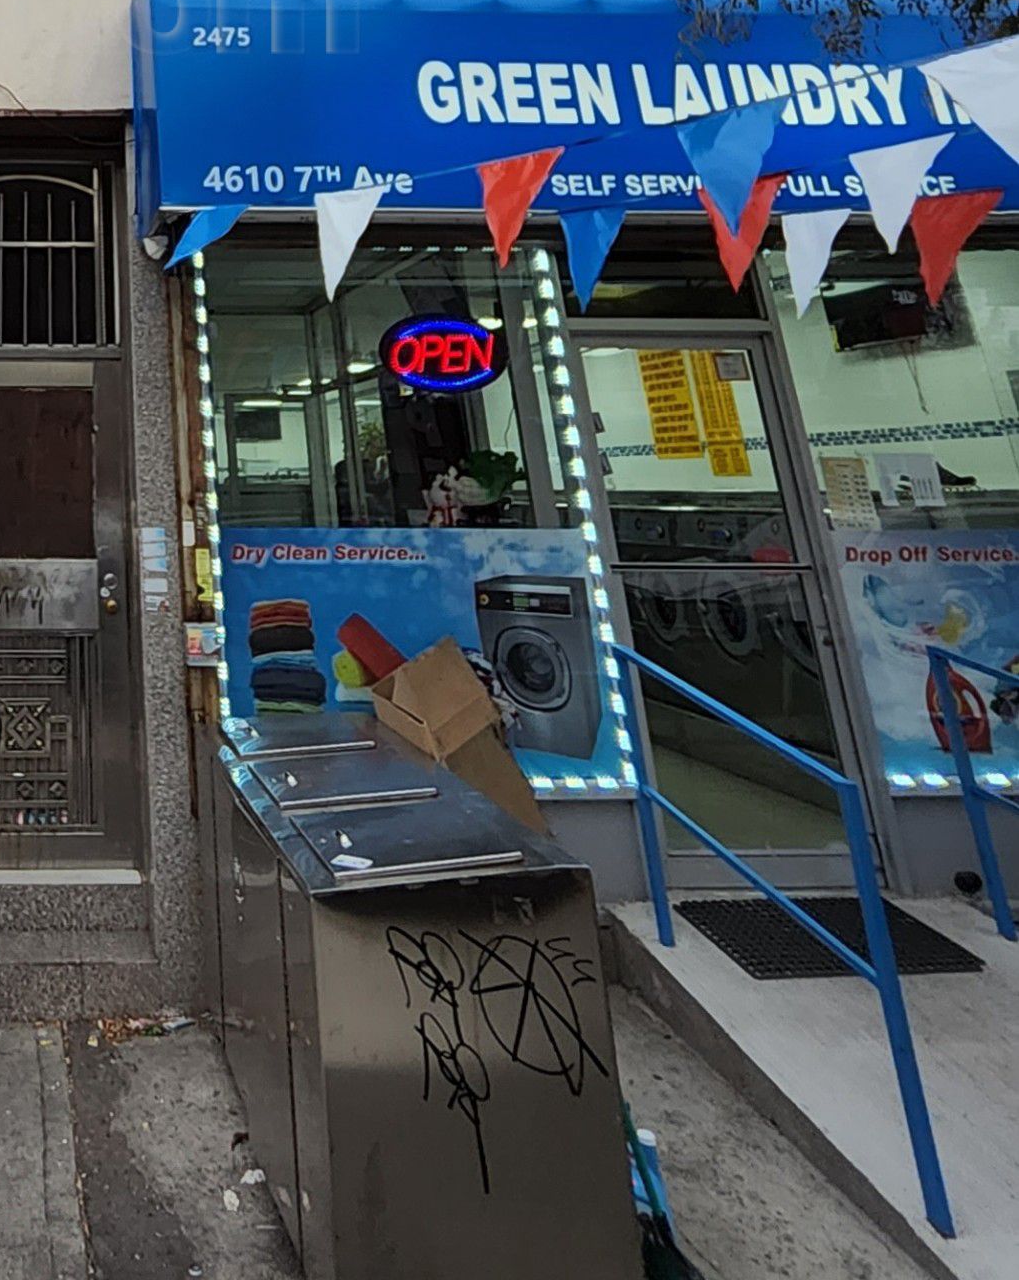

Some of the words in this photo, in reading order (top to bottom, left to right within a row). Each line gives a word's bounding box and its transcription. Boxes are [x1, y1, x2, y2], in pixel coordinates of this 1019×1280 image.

[192, 26, 251, 47] 2475
[417, 60, 621, 125] GREEN
[202, 165, 285, 194] 4610
[292, 165, 342, 193] 7TH
[352, 165, 414, 195] Ave
[550, 174, 617, 197] SELF
[624, 174, 703, 197] SERVI
[389, 332, 495, 374] OPEN
[232, 545, 266, 563] Dry
[272, 545, 328, 561] Clean
[845, 546, 892, 566] Drop
[899, 546, 928, 562] Off
